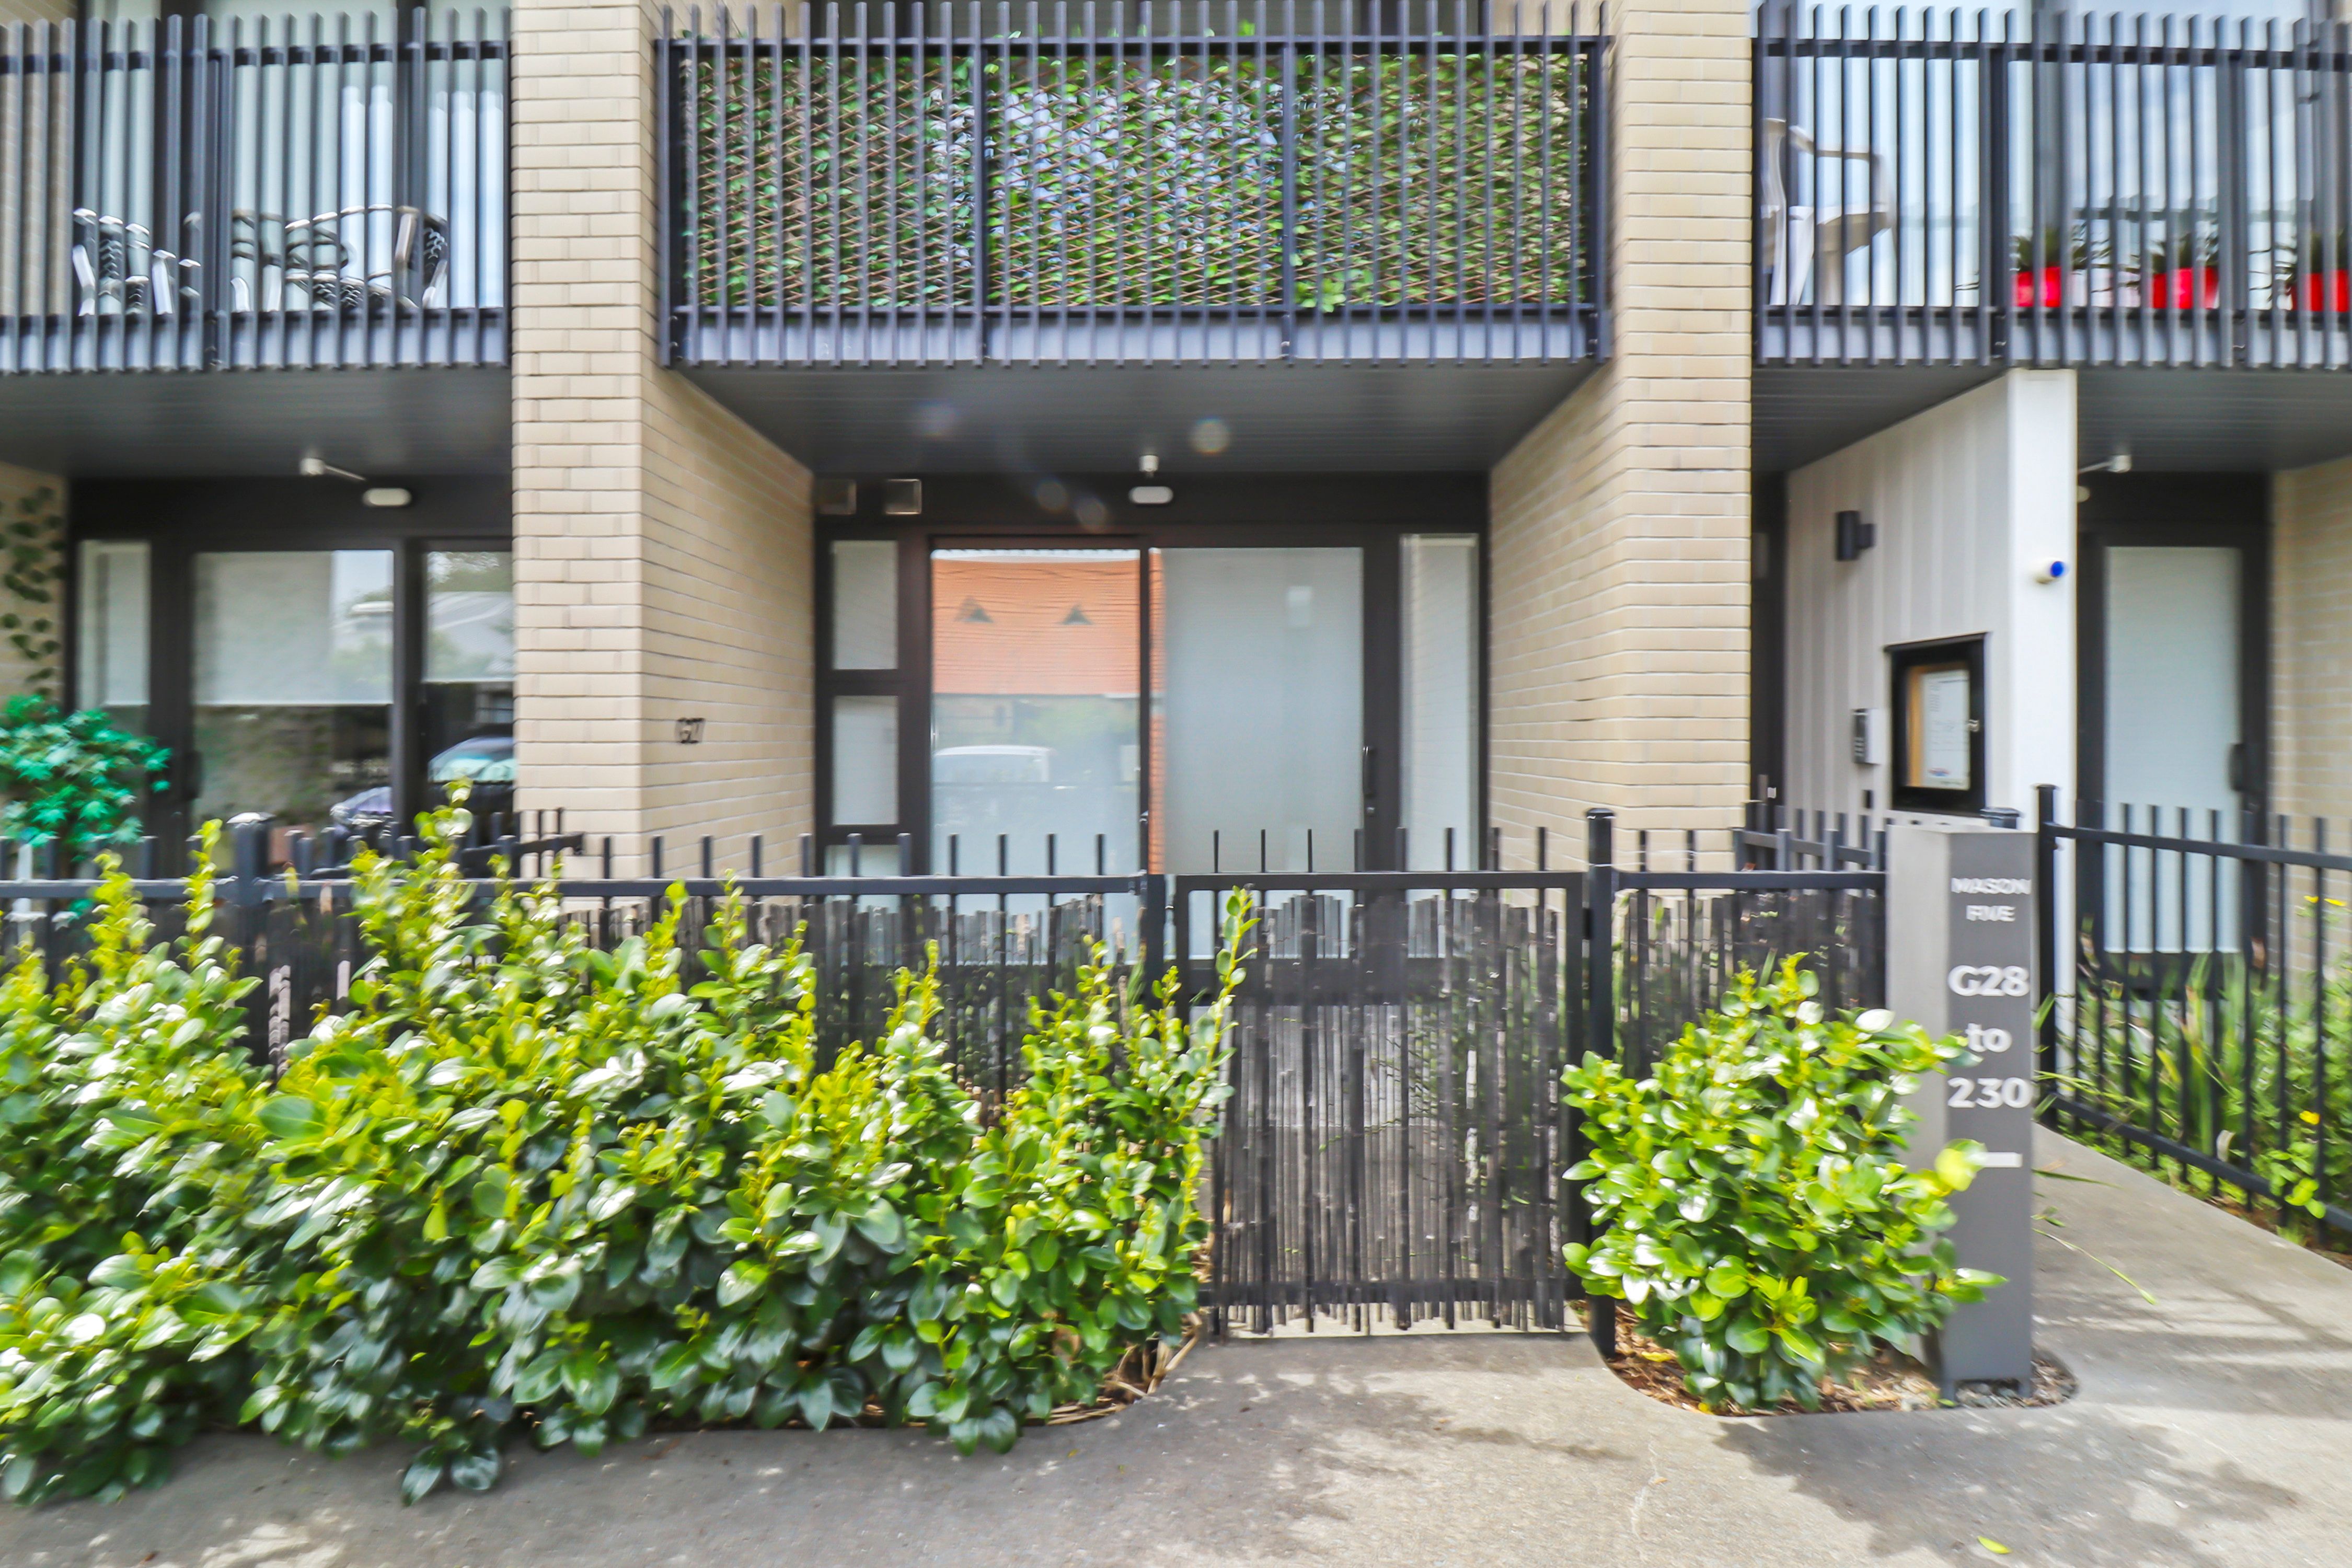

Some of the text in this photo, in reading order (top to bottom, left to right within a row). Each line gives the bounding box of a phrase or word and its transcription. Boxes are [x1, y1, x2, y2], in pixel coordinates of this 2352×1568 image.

[1951, 878, 2032, 894] MASON
[1966, 905, 2015, 921] FIVE
[1948, 965, 2030, 997] G28
[1965, 1022, 2012, 1053] to
[1947, 1077, 2032, 1109] 230
